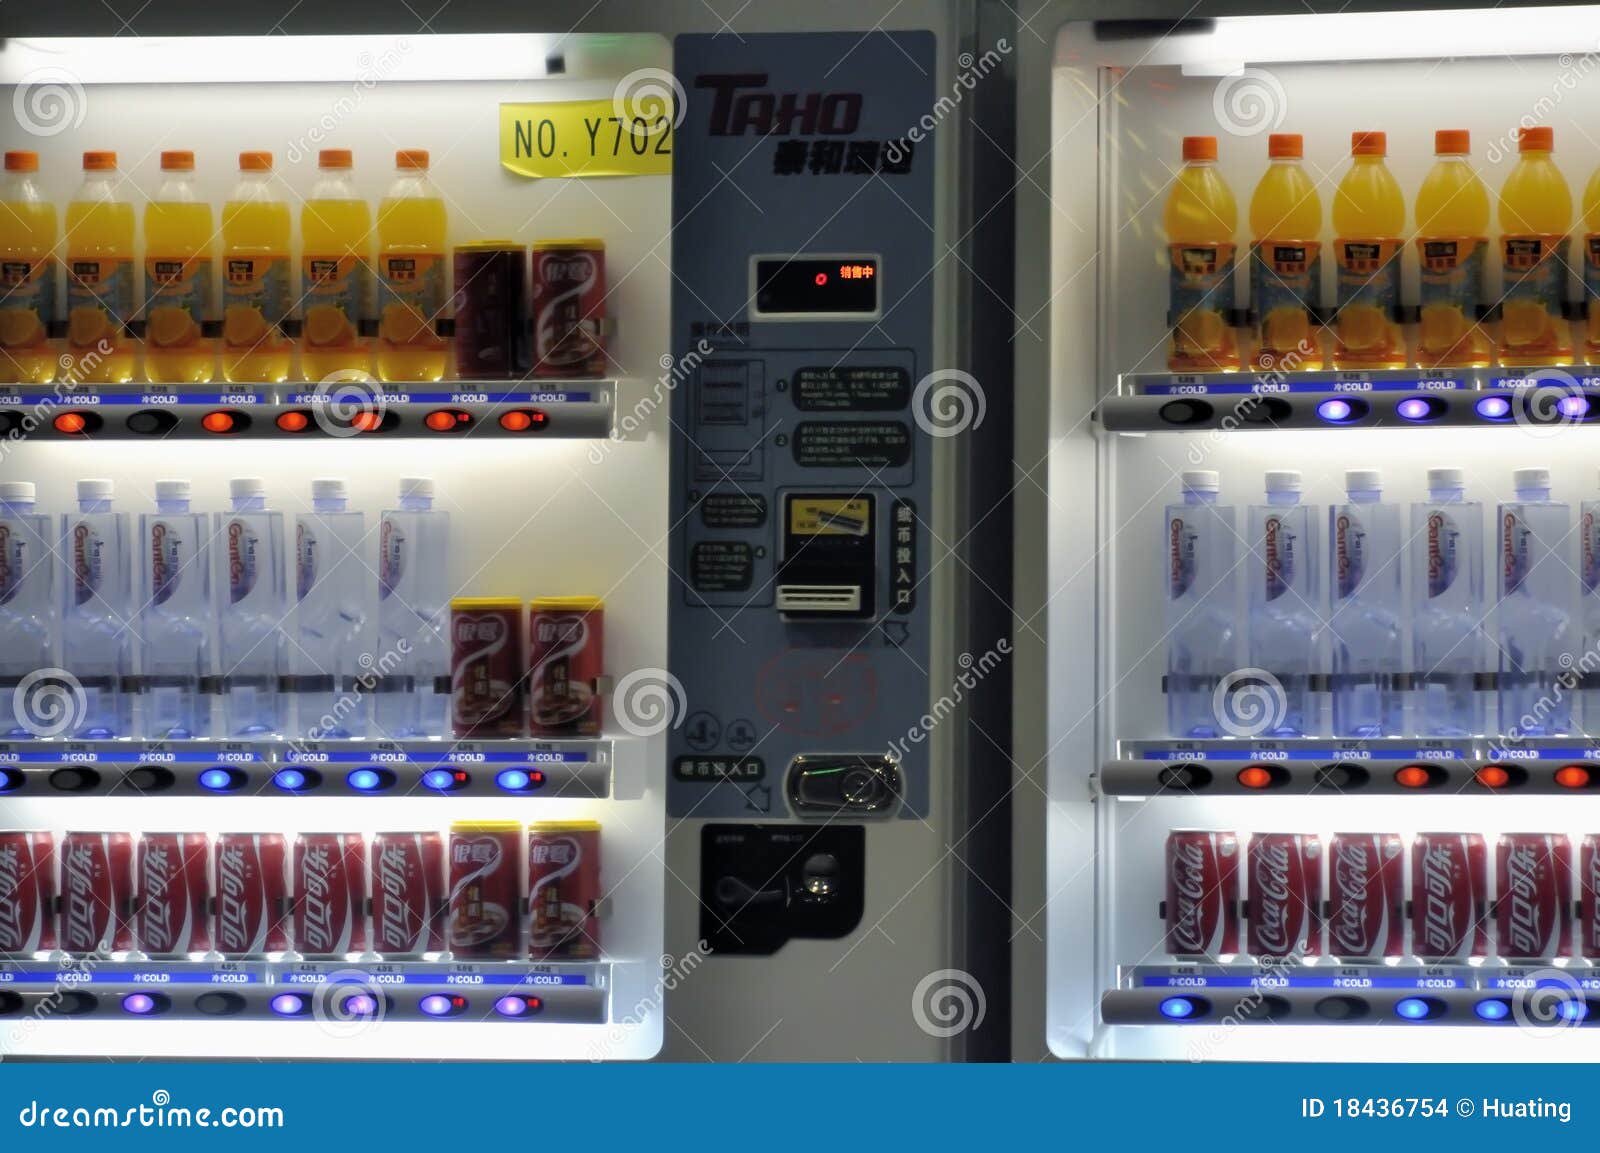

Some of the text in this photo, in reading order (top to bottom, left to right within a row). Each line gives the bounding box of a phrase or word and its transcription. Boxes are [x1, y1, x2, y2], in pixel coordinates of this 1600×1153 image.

[695, 73, 863, 136] TAHO
[840, 265, 873, 279] 销售中
